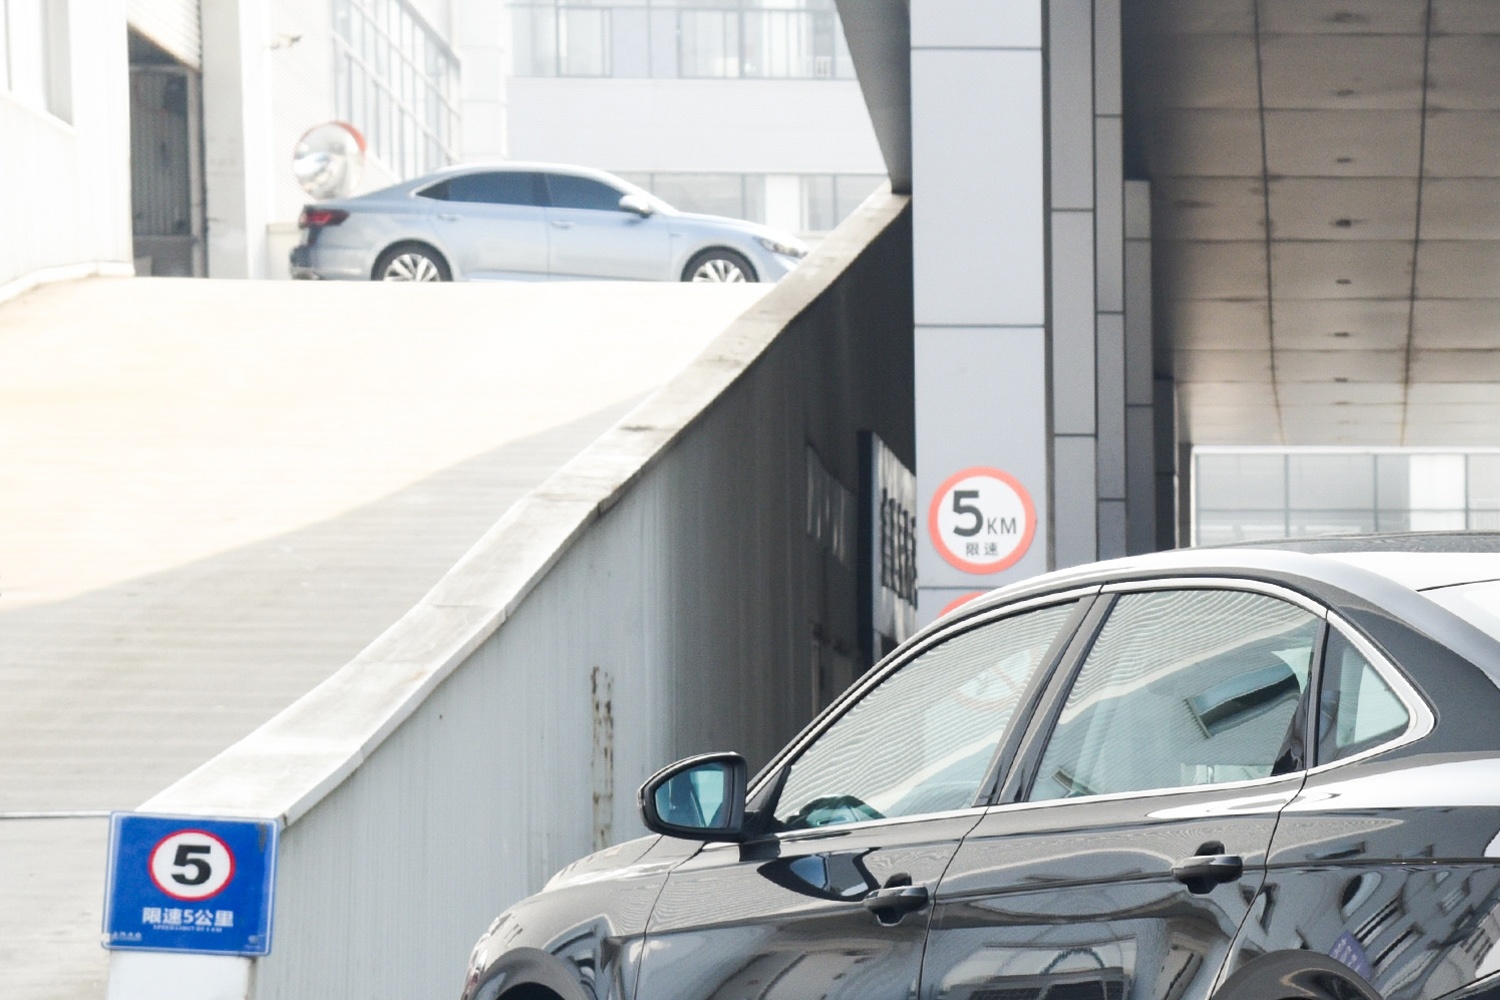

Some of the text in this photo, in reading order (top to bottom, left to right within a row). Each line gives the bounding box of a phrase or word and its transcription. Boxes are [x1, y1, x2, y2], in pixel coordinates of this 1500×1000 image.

[965, 542, 999, 556] 限速
[171, 844, 212, 885] 5
[142, 907, 234, 927] 限速5公里
